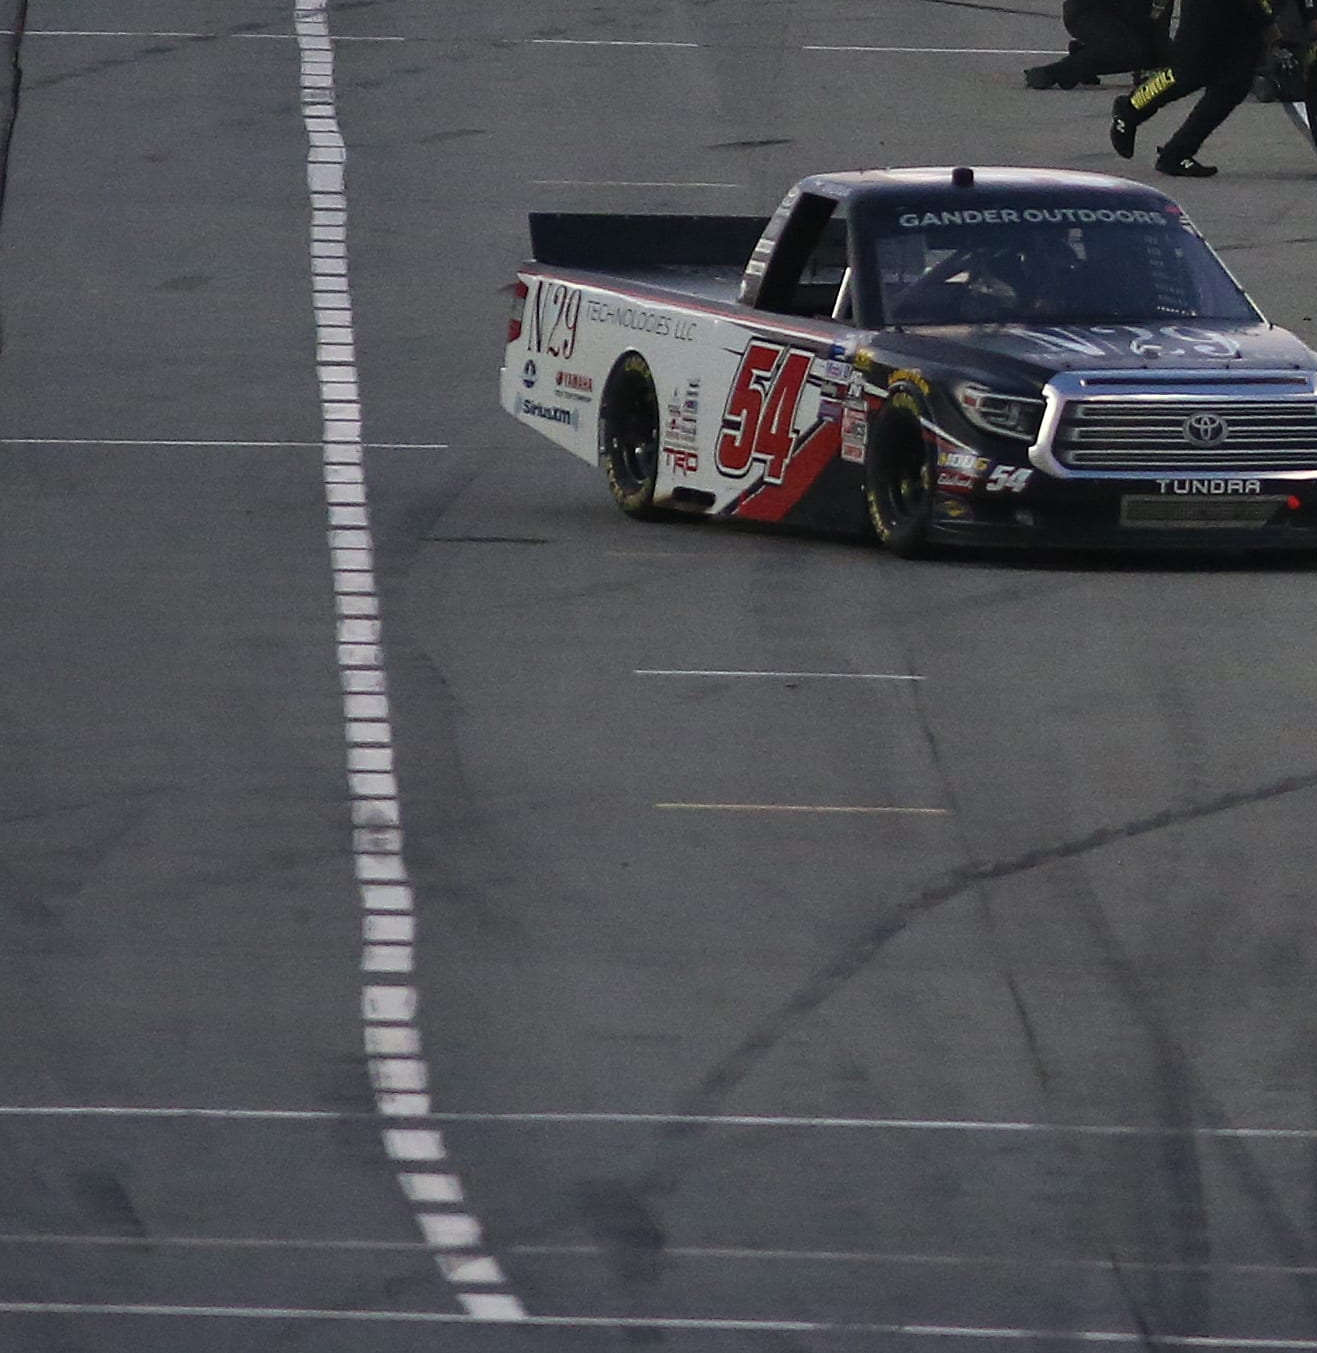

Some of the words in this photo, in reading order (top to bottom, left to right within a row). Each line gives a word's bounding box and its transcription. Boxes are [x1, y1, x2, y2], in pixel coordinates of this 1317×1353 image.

[900, 208, 1022, 228] GANDER
[1022, 207, 1167, 227] OUTDOORS
[528, 280, 582, 360] N29
[674, 321, 698, 341] LLC
[715, 336, 815, 485] 54
[985, 465, 1034, 493] 54
[1155, 479, 1260, 495] TUNDRA
